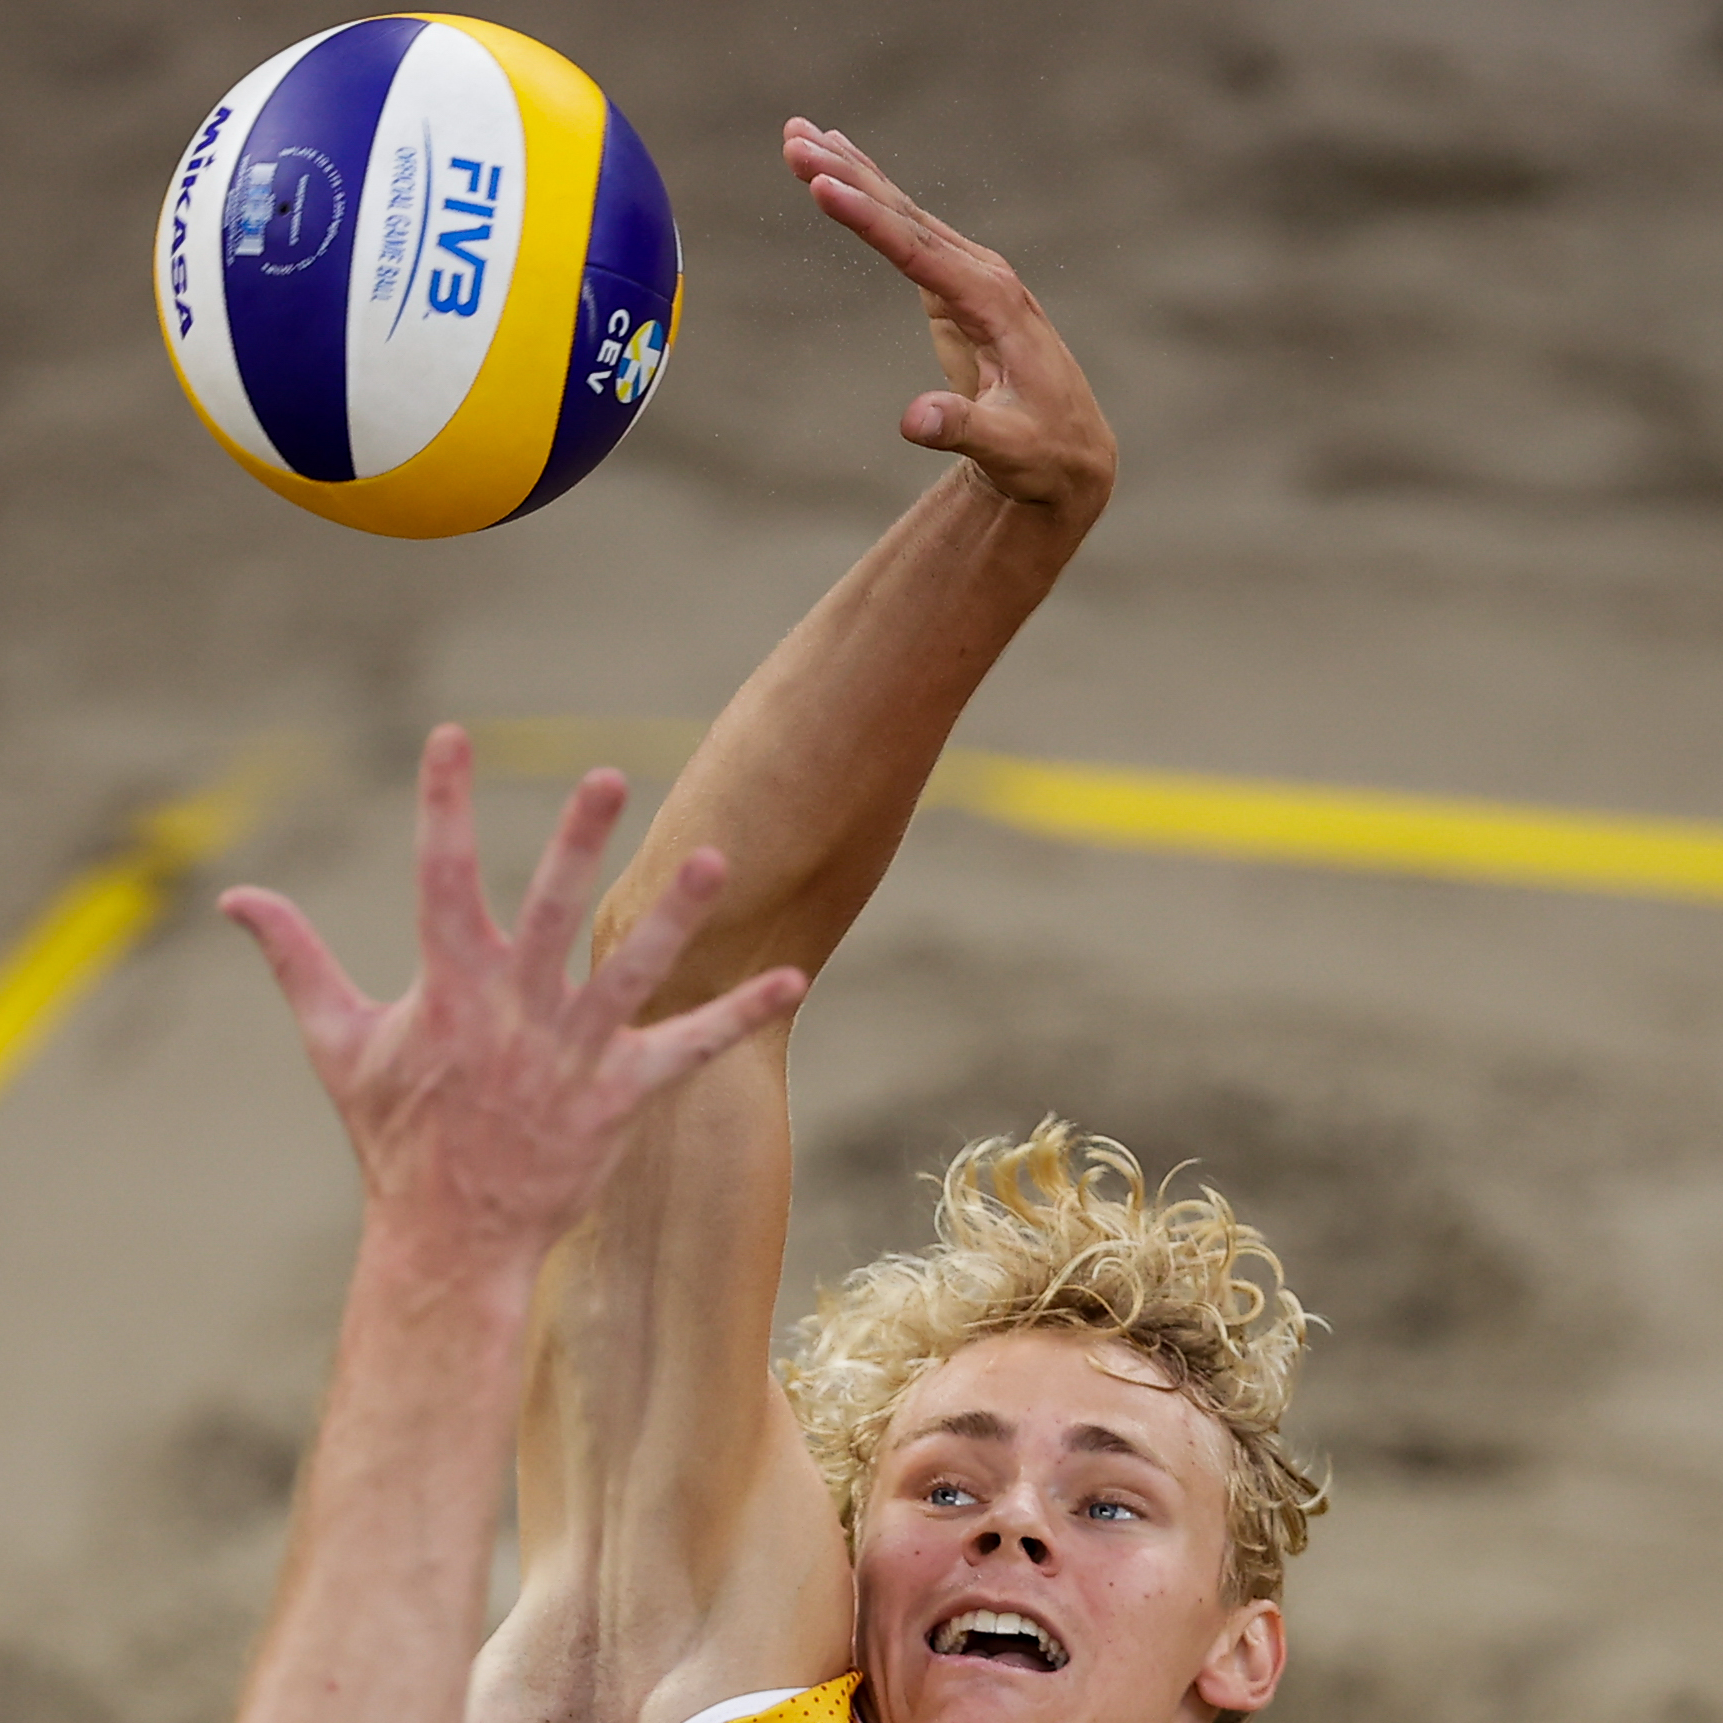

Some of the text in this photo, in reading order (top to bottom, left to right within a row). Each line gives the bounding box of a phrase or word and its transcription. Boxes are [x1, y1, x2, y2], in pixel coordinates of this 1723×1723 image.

[379, 214, 413, 264] GAME
[427, 157, 503, 318] FIVB
[586, 309, 630, 394] CEV
